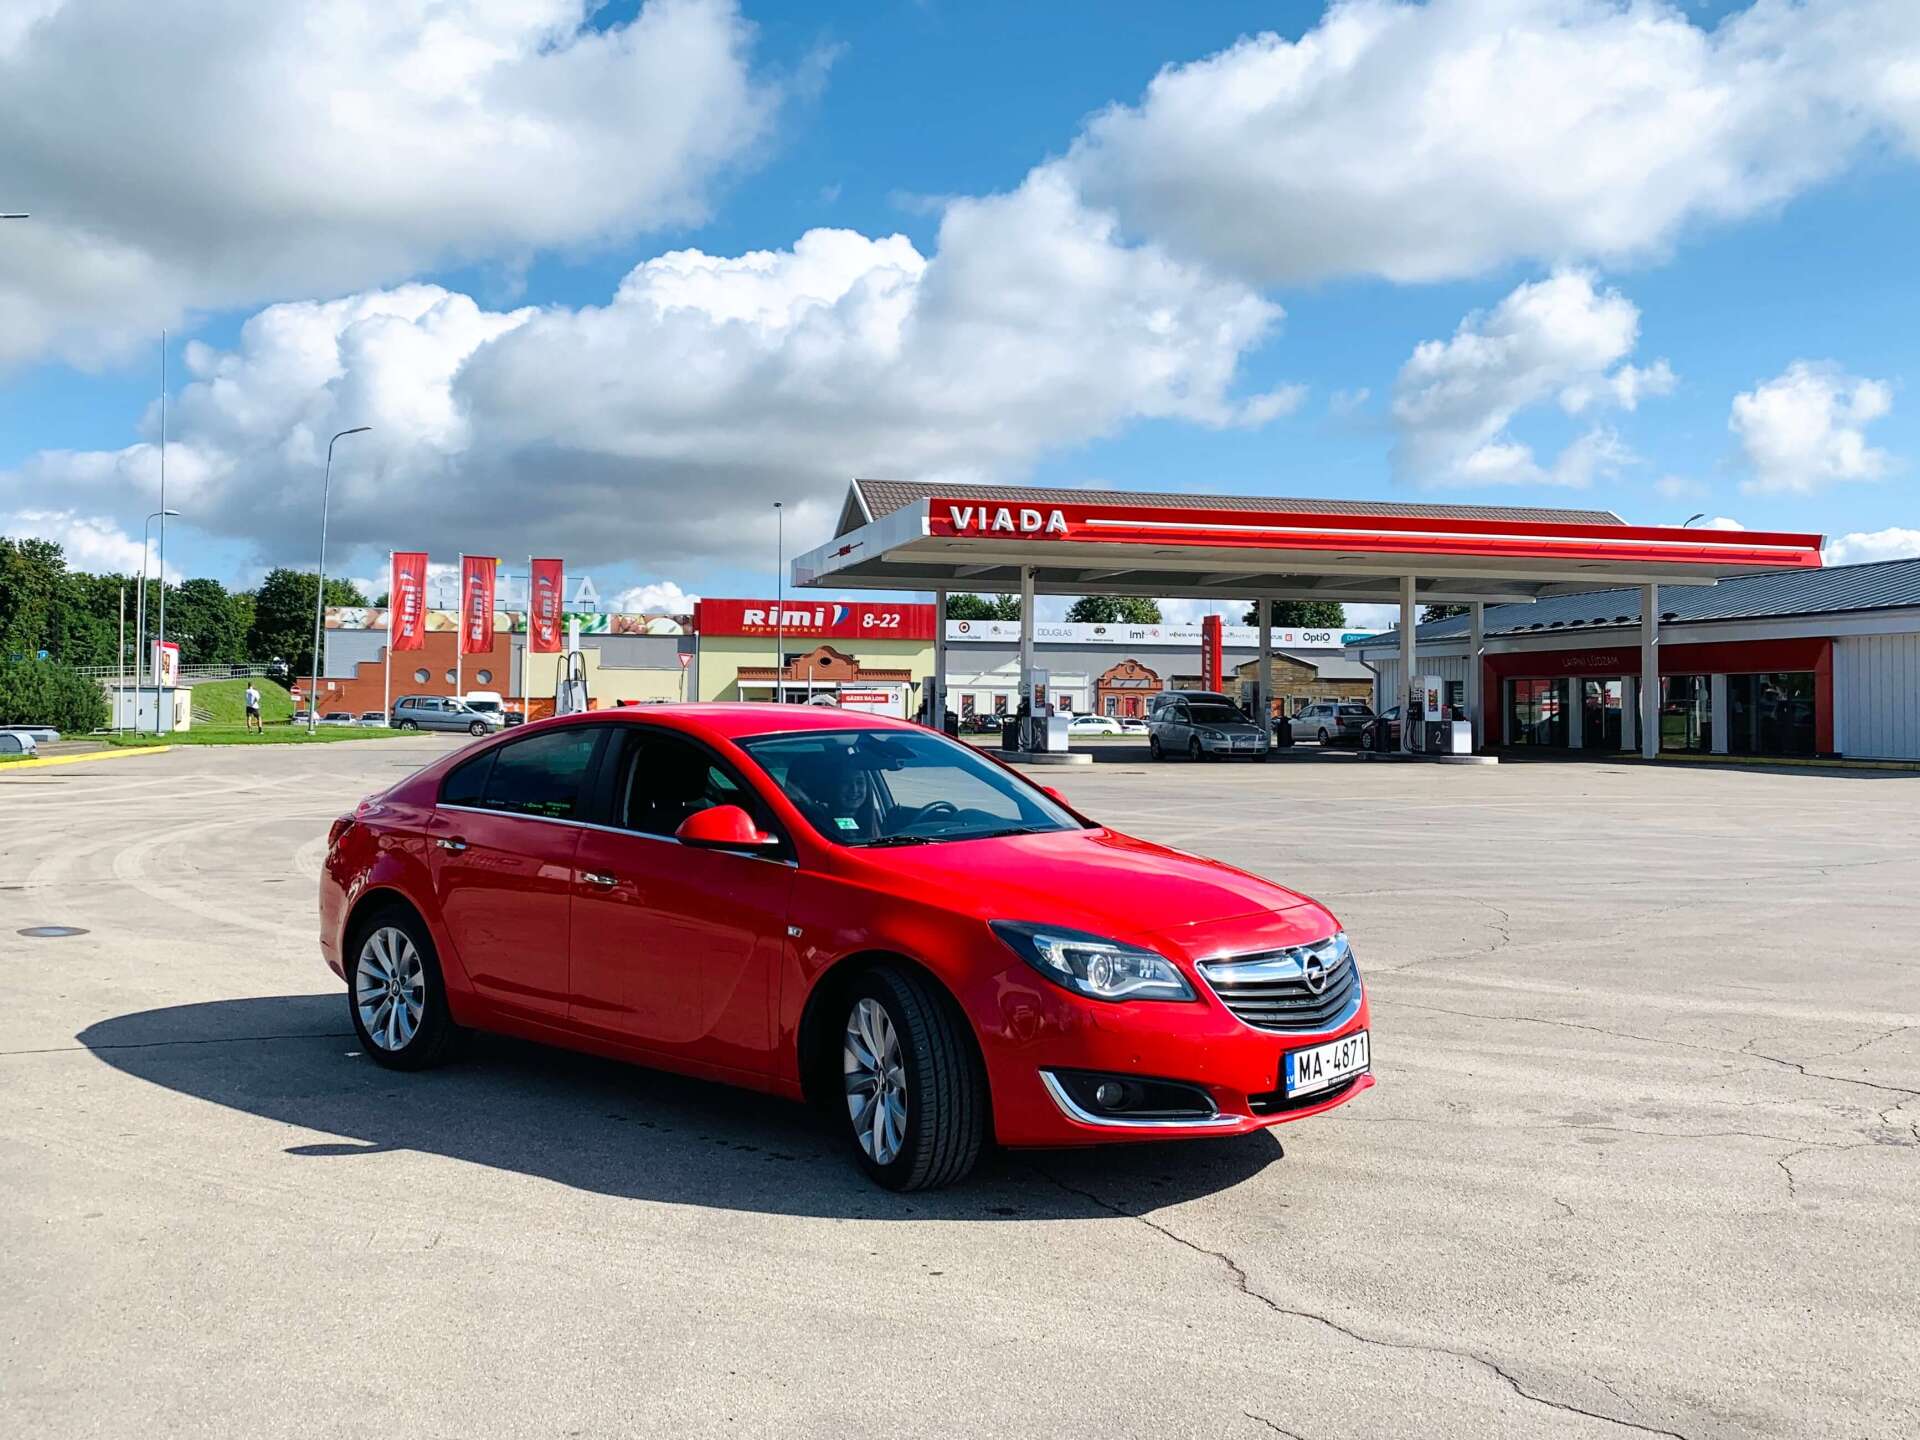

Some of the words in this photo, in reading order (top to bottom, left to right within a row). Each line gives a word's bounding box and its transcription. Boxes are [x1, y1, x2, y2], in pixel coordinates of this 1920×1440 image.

[949, 505, 1068, 533] VIADA
[743, 606, 825, 627] Rimi
[862, 613, 901, 629] 8-22
[1037, 628, 1073, 637] DOUGLAS
[1434, 731, 1441, 744] 2
[1299, 1036, 1366, 1083] MA-4871
